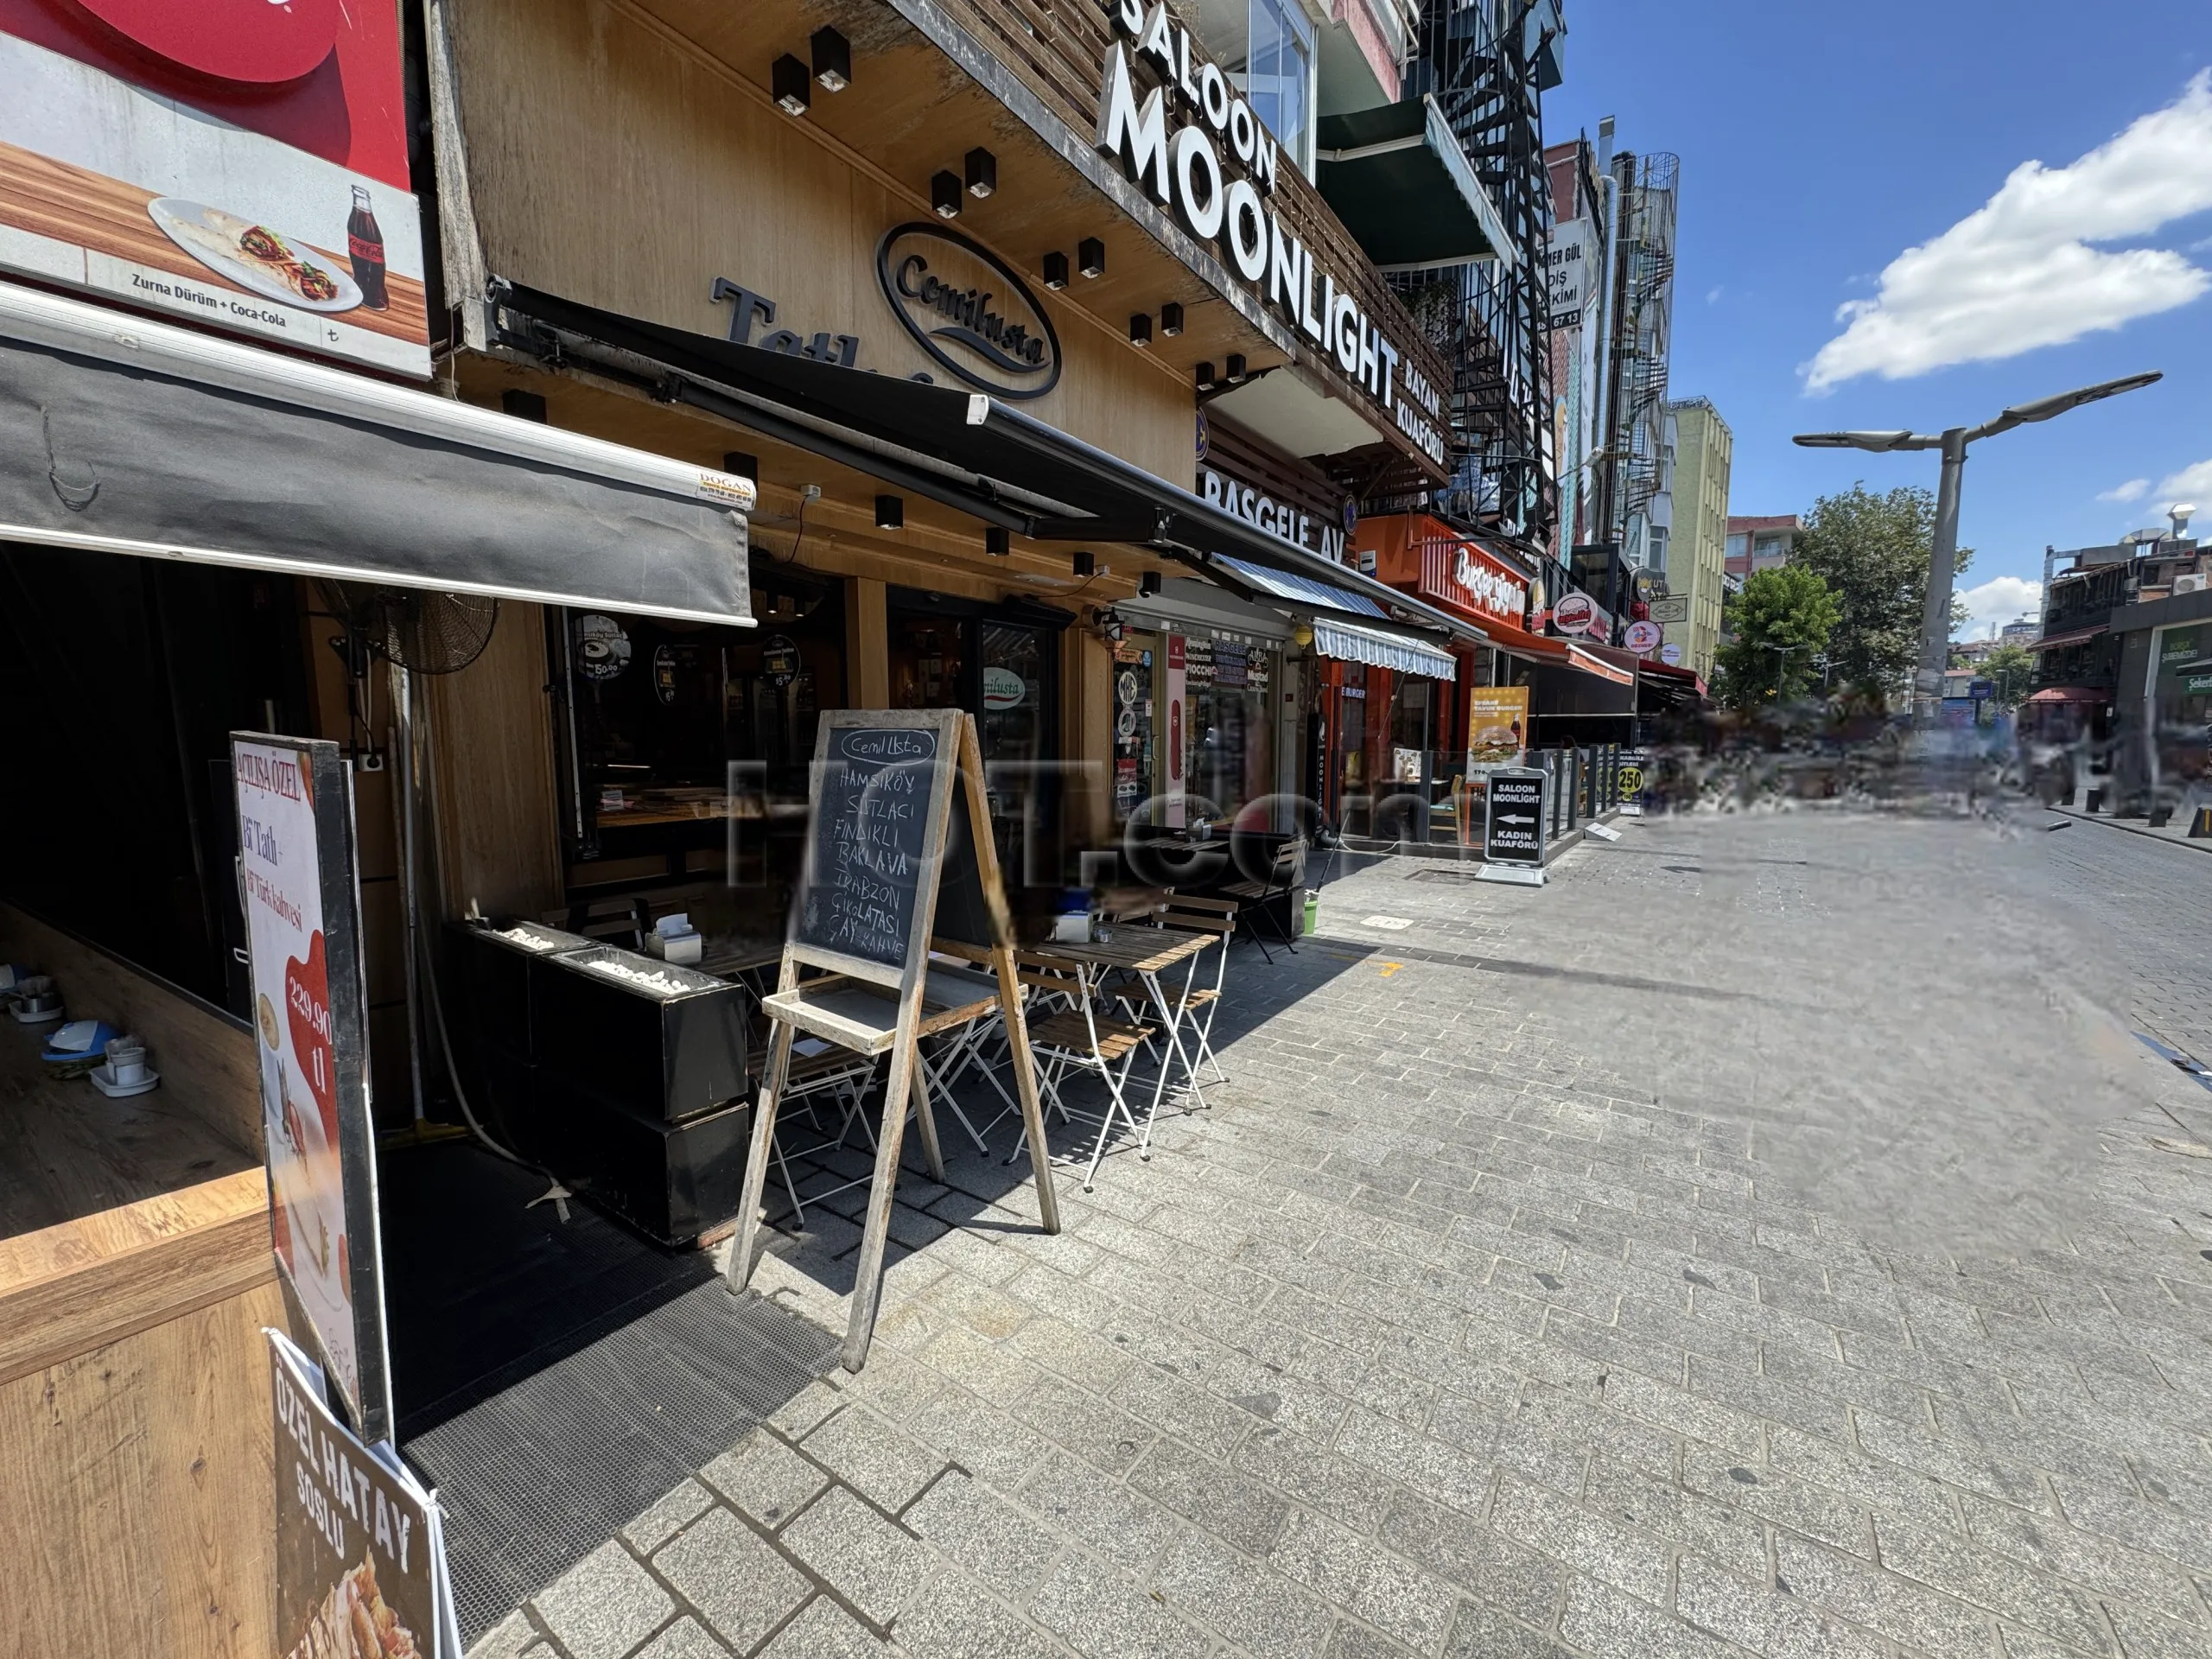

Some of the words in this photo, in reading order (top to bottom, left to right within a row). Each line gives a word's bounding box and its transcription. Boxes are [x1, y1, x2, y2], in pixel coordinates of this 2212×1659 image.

[1100, 40, 1398, 409] MOONLIGHT
[1565, 243, 1581, 262] GÜL
[1548, 270, 1567, 287] DİŞ
[132, 274, 171, 296] Zurna
[175, 286, 217, 308] Dürüm
[231, 302, 286, 327] Coca-Cola
[895, 255, 1045, 365] Cemilusta
[1554, 316, 1565, 327] 67
[1567, 312, 1578, 323] 13
[1406, 359, 1440, 421] BAYAN
[1397, 398, 1444, 465] KUAFÖRÜ
[1320, 524, 1344, 563] AV
[1457, 547, 1494, 607] Burger
[1185, 664, 1211, 677] FIOCCHI
[1247, 669, 1268, 683] Mustad
[851, 736, 886, 754] Cemil
[237, 753, 271, 799] AÇILIŞA
[272, 751, 301, 802] ÖZEL
[1498, 784, 1535, 793] SALOON
[1618, 771, 1641, 788] 250
[833, 819, 899, 849] FINDIKLI
[1491, 839, 1538, 849] KUAFÖRÜ
[1497, 830, 1532, 840] KADIN
[836, 842, 908, 876] BAKLAVA
[833, 867, 899, 910] TRABZON
[289, 976, 333, 1046] 229.90
[275, 1353, 320, 1476] ÖZEL
[321, 1430, 410, 1574] HATAY
[296, 1461, 345, 1560] SOSLU
